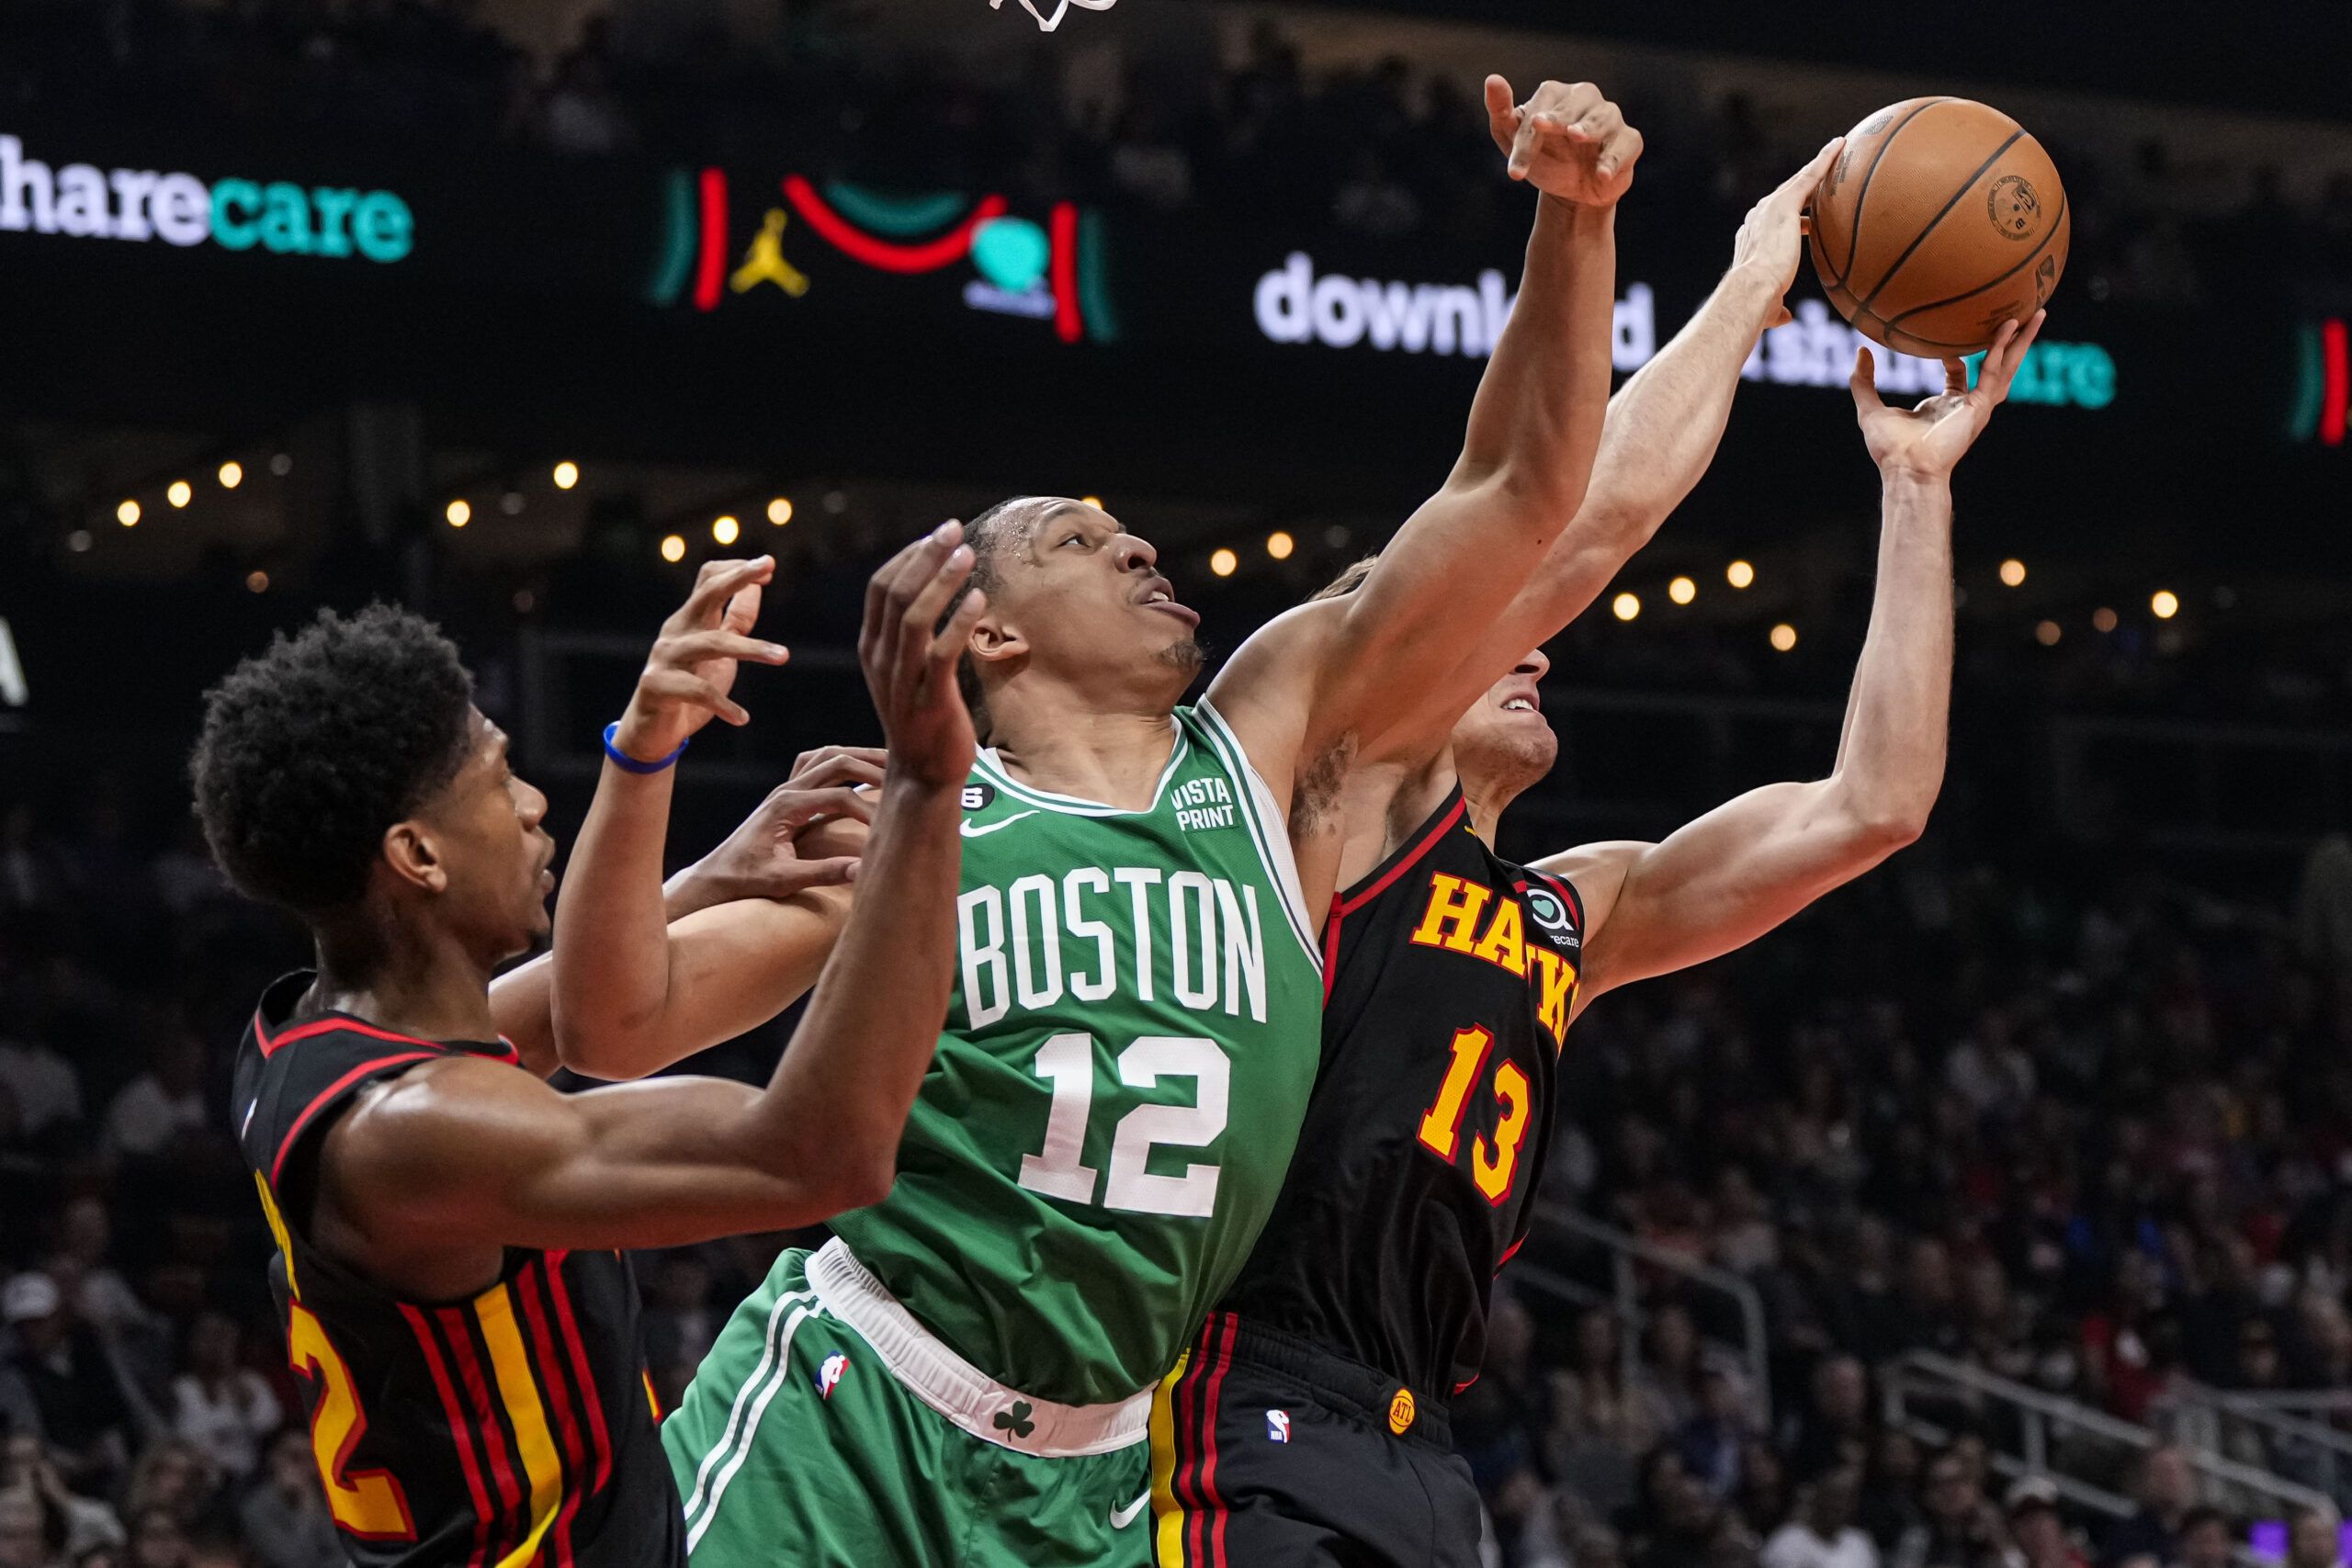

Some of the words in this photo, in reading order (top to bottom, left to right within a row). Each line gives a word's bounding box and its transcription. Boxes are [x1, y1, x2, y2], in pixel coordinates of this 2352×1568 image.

[1253, 251, 1653, 369] downld
[961, 787, 983, 808] 6
[1170, 777, 1231, 811] VISTA
[1176, 804, 1235, 831] PRINT
[956, 866, 1268, 1032] BOSTON
[1408, 870, 1579, 1058] HAK
[1017, 1032, 1231, 1218] 12
[1416, 1021, 1531, 1209] 13
[287, 1296, 418, 1542] 2
